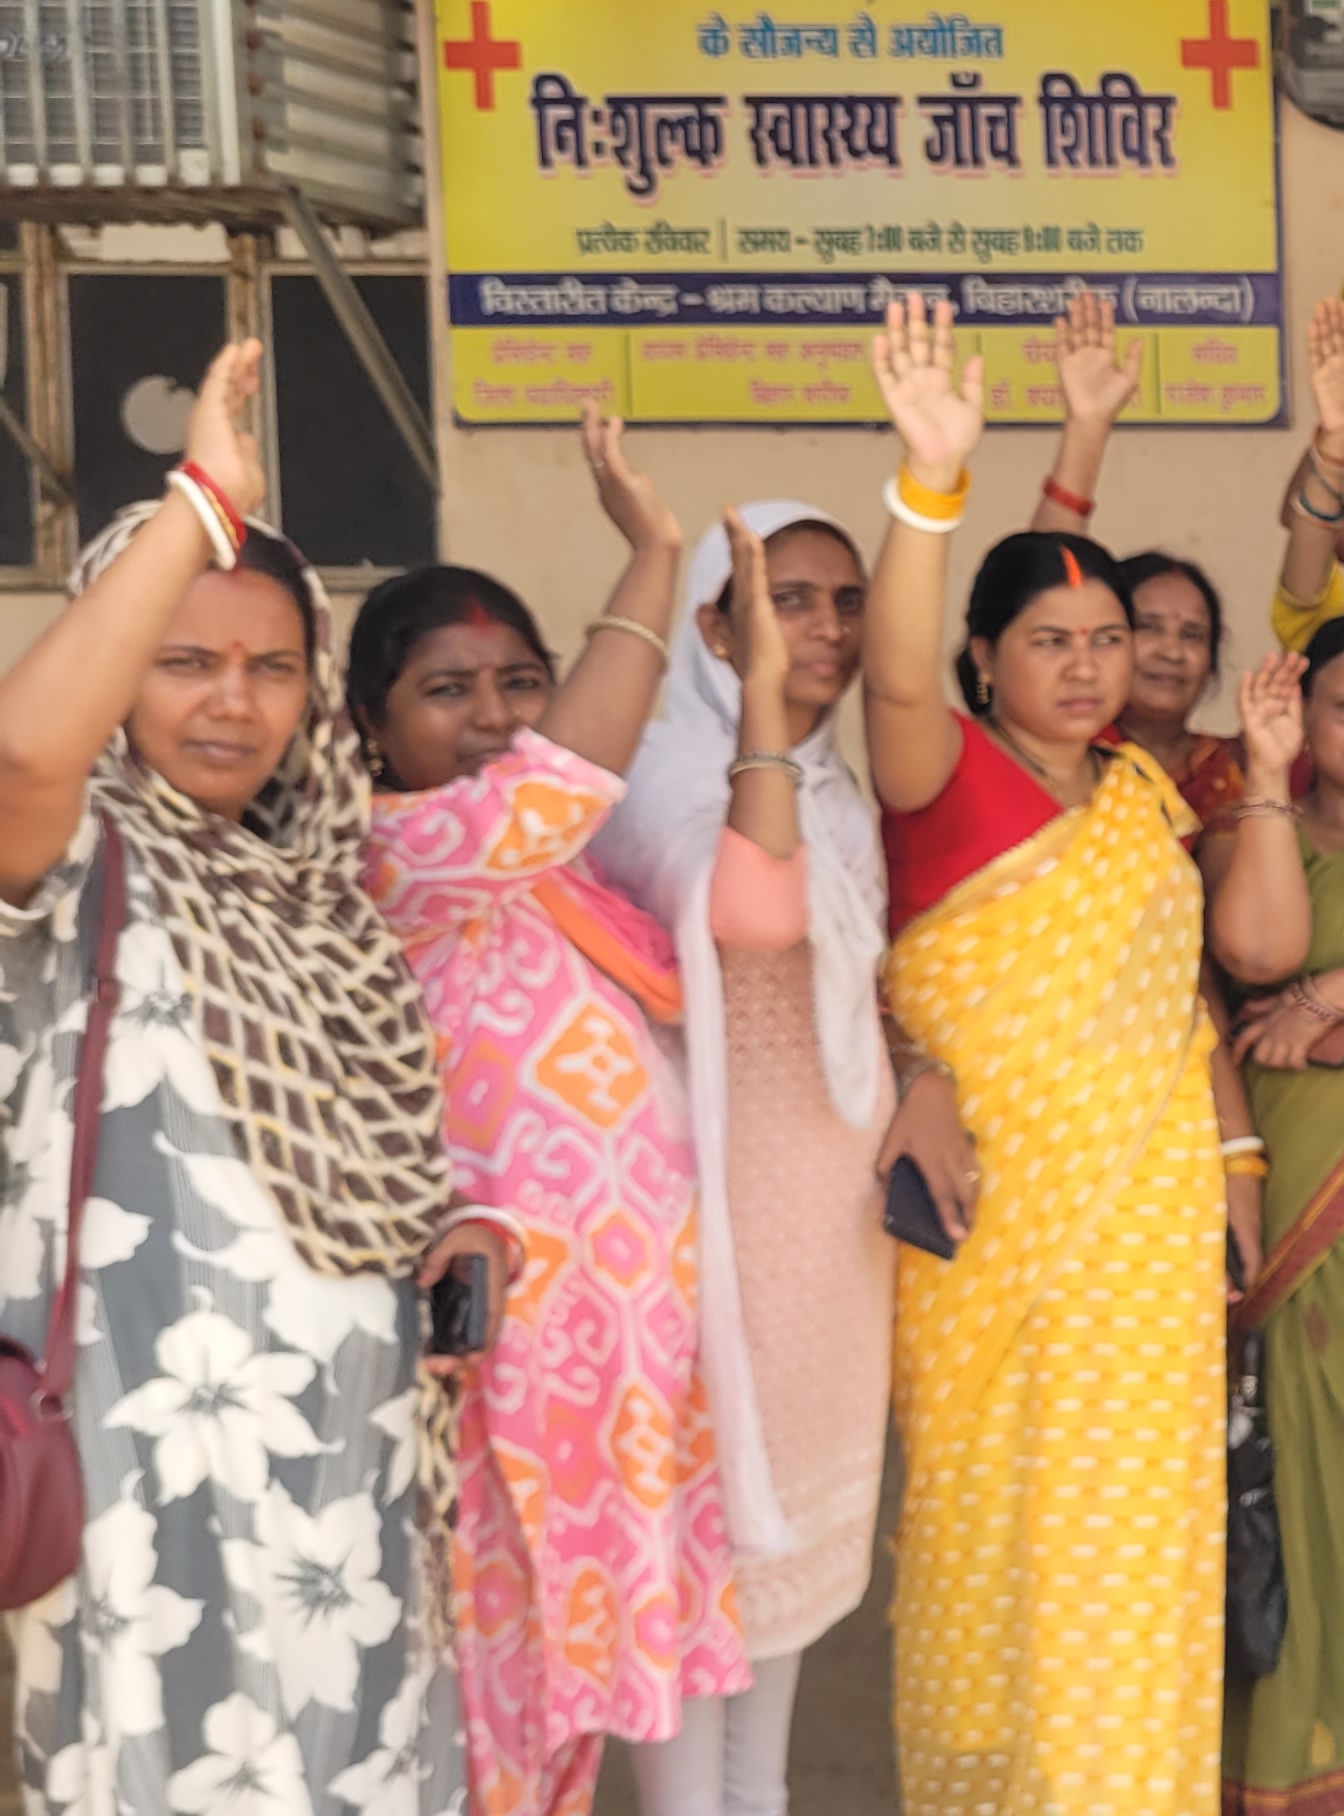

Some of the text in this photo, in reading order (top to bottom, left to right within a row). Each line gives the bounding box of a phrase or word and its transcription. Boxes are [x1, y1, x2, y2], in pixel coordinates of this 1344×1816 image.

[698, 12, 730, 57] के
[738, 11, 839, 58] सौजन्य
[847, 11, 877, 58] से
[916, 72, 1022, 172] जाँच
[1038, 72, 1178, 172] शिविर
[907, 220, 942, 254] बजे
[947, 219, 967, 254] से
[1105, 227, 1144, 254] तक
